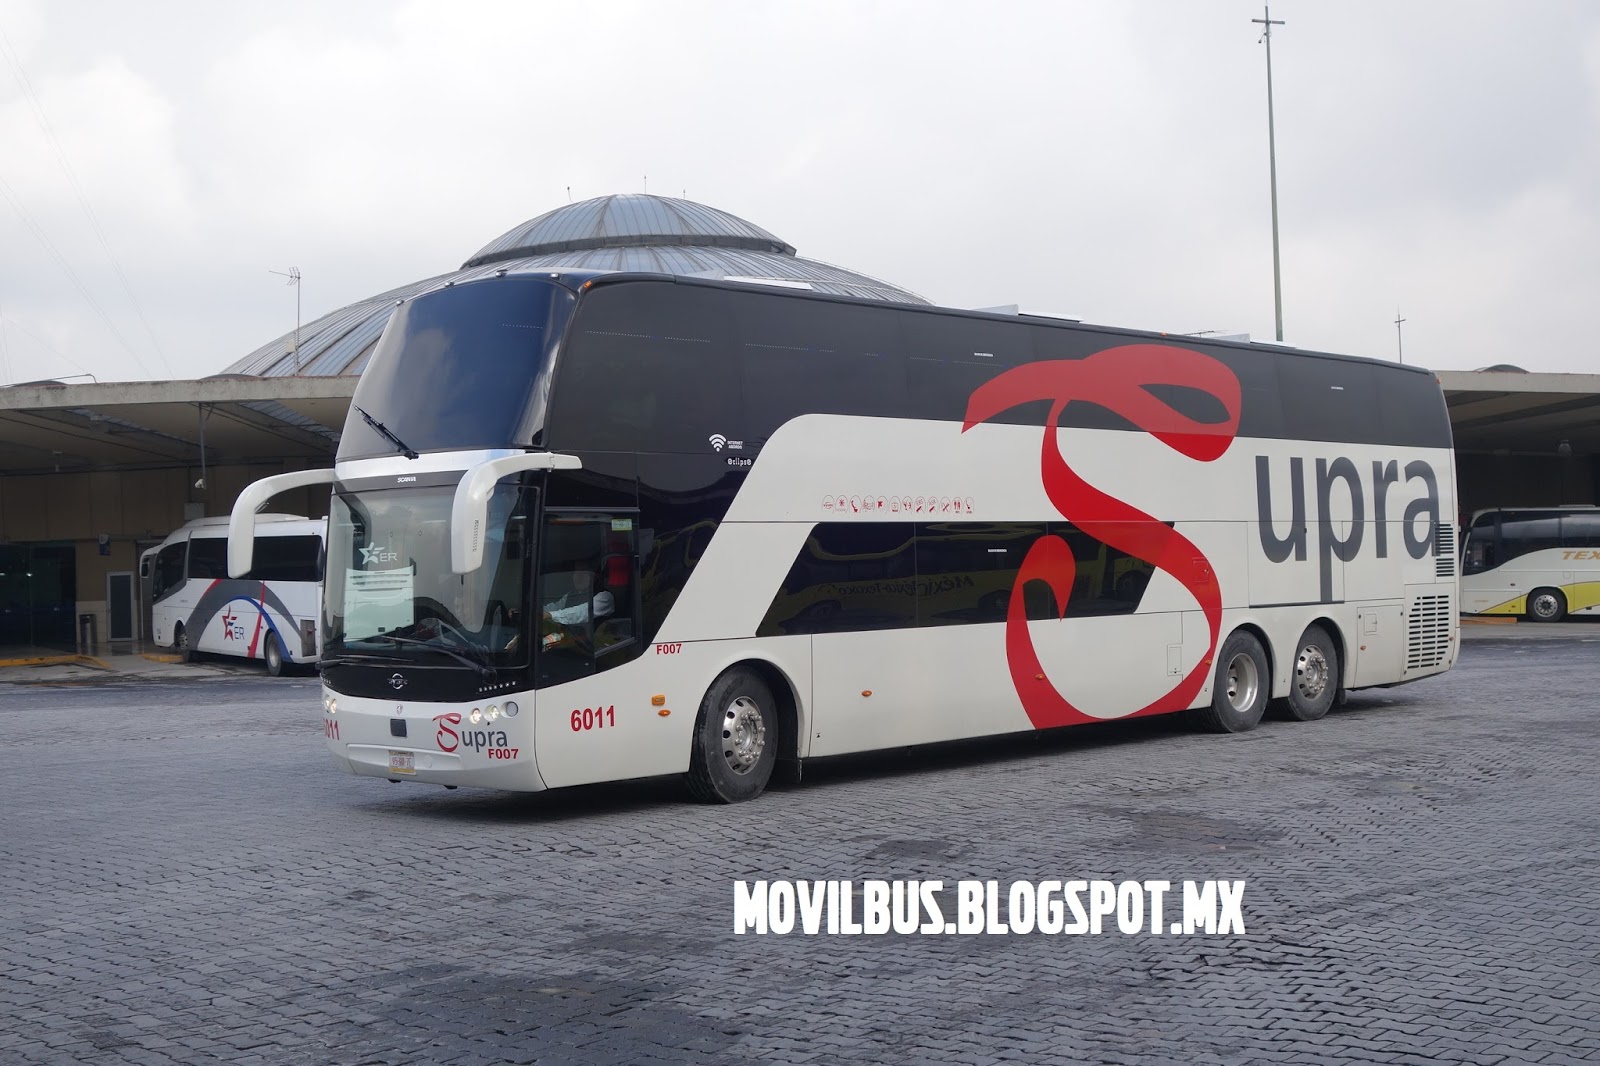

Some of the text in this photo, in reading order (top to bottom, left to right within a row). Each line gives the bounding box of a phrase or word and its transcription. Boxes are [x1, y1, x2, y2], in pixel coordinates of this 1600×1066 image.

[962, 344, 1440, 730] Supra
[379, 552, 398, 562] ER
[234, 626, 245, 640] ER
[656, 643, 682, 655] F007
[570, 705, 615, 732] 6011
[432, 712, 508, 753] Supra
[487, 748, 519, 760] F007
